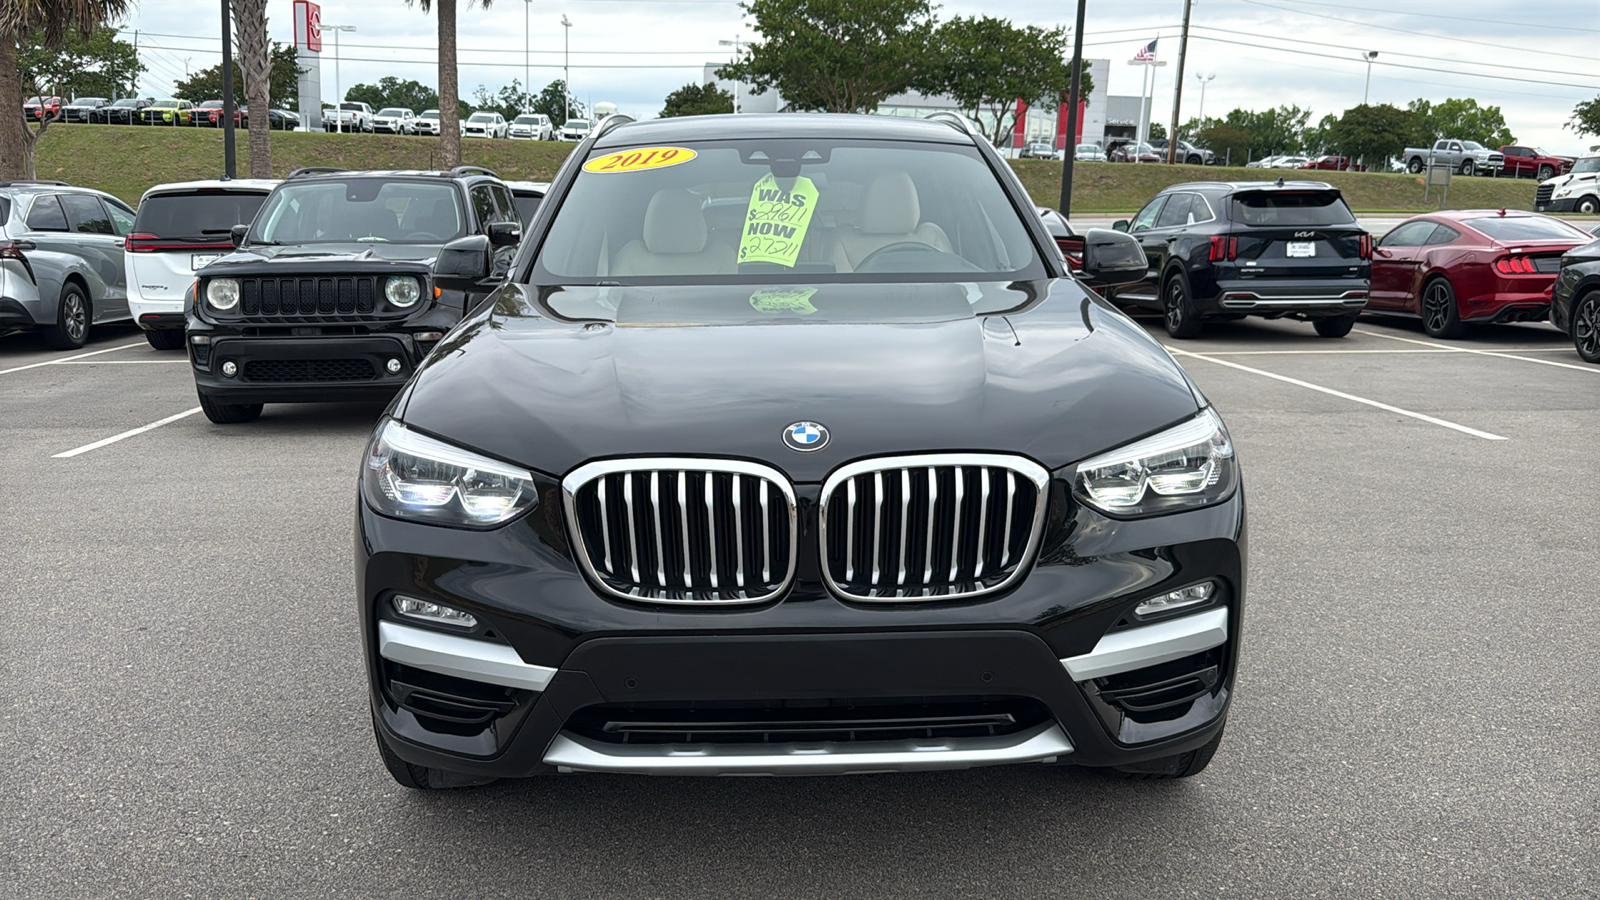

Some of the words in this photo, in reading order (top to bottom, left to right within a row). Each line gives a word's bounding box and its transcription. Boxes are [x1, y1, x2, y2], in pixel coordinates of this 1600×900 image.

[1106, 117, 1134, 125] Service
[600, 149, 679, 170] 2019
[758, 189, 807, 208] WAS
[747, 222, 797, 239] NOW
